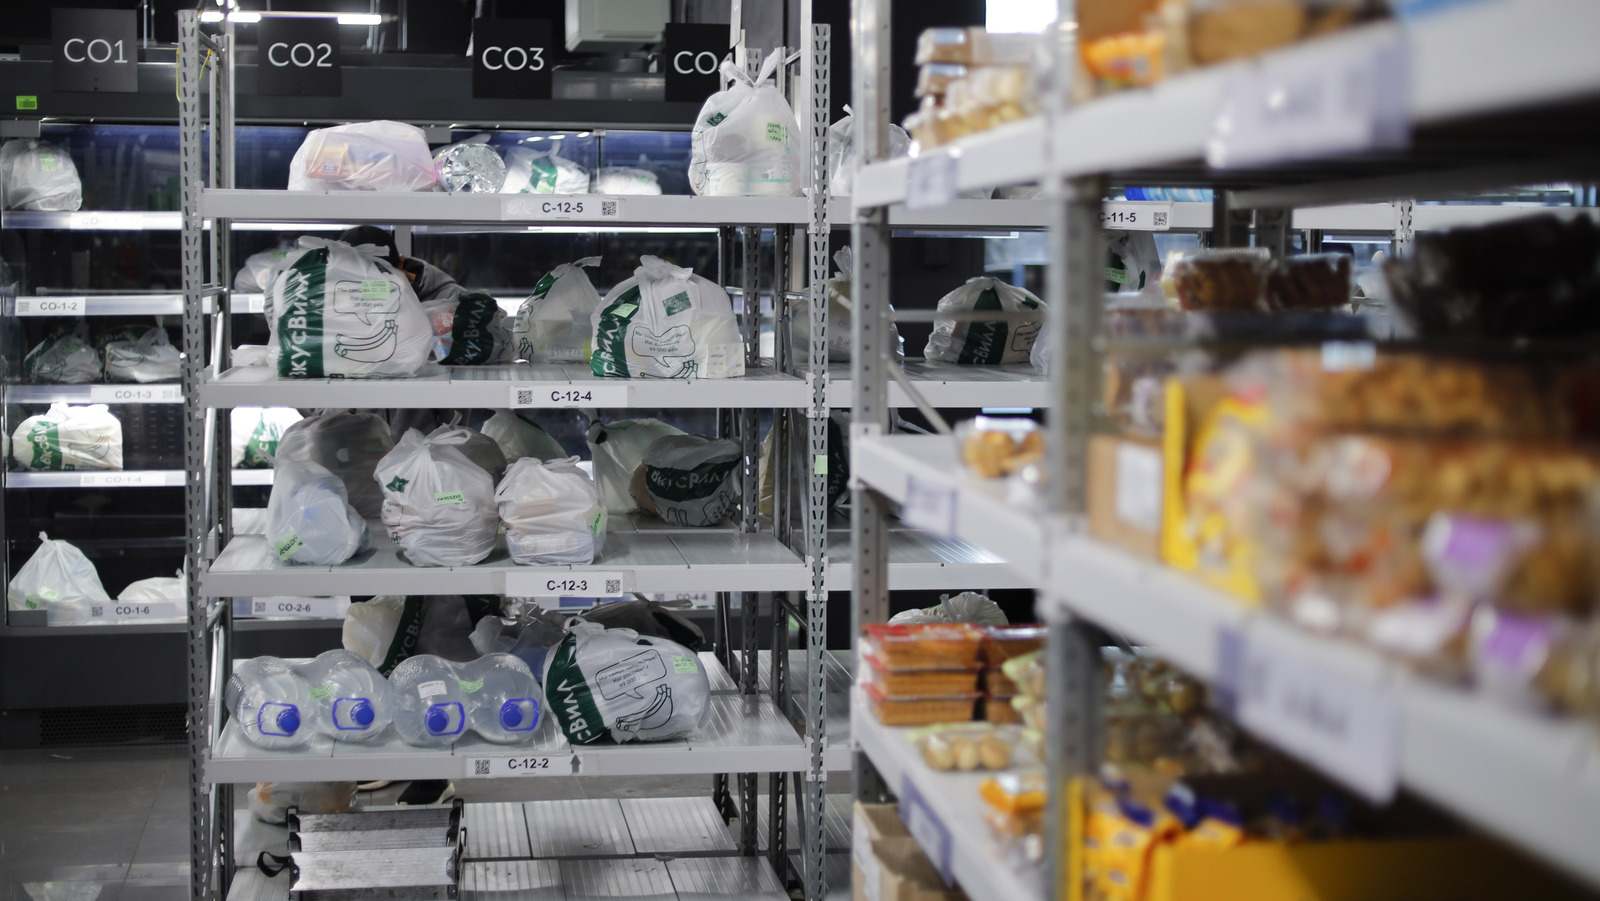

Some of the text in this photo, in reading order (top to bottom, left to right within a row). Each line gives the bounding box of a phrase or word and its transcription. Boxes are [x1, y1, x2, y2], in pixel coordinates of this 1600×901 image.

[541, 202, 584, 214] C-12-5
[39, 301, 78, 311] CO-1-2
[114, 390, 152, 399] CO-1-3
[550, 390, 593, 402] C-12-4
[546, 580, 588, 592] C-12-3
[115, 606, 150, 615] CO-1-6
[278, 603, 312, 612] CO-2-6
[507, 757, 550, 770] C-12-2
